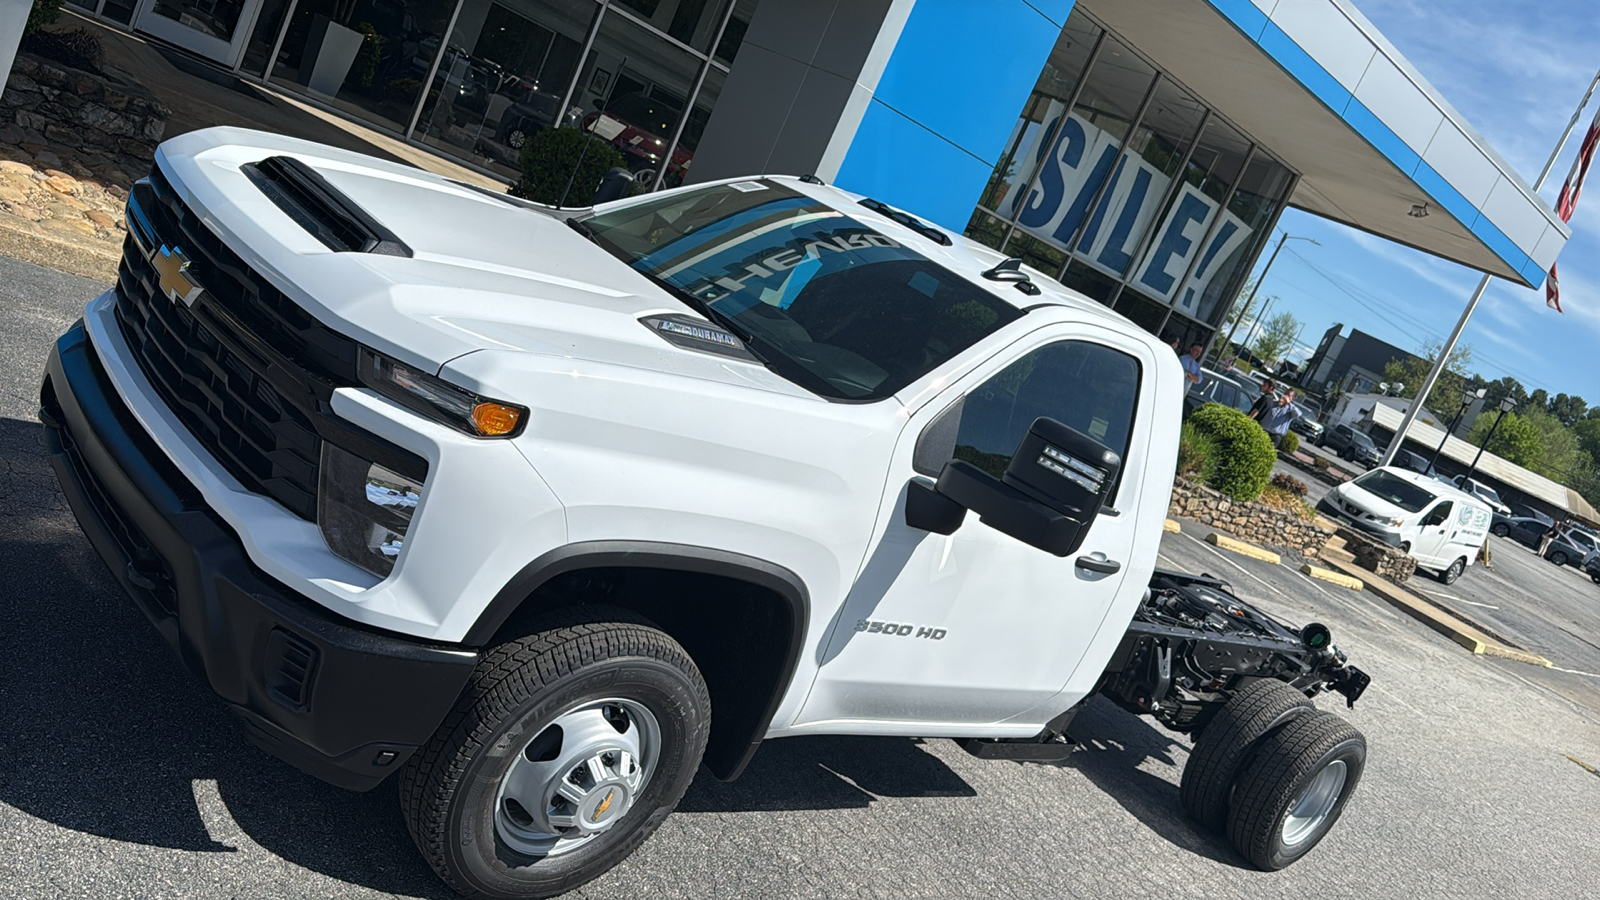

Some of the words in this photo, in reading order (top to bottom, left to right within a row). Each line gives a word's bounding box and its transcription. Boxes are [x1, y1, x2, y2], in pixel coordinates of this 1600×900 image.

[1012, 115, 1239, 309] SALE!
[692, 327, 735, 345] DURAMAX
[855, 618, 914, 636] 3500
[916, 626, 947, 640] HD
